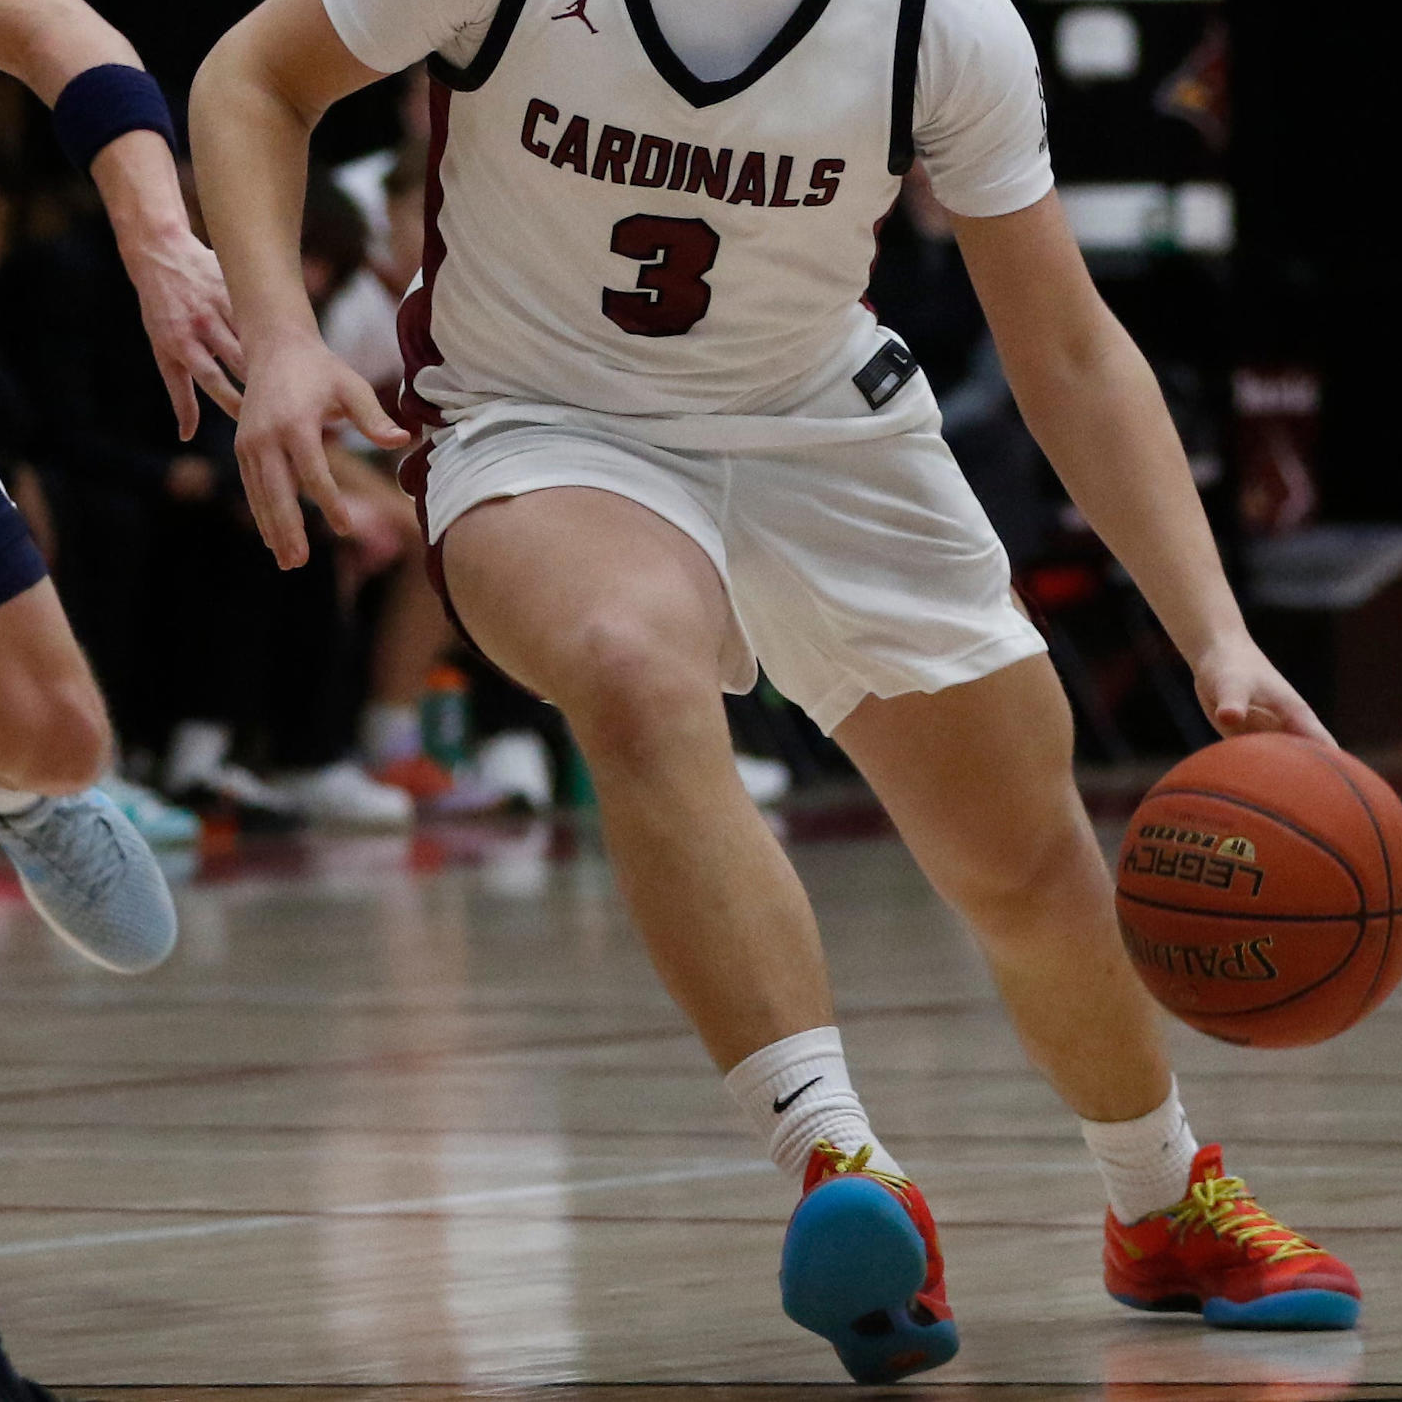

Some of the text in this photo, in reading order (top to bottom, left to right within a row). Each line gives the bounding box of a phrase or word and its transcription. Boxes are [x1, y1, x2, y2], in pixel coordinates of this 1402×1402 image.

[520, 97, 847, 209] CARDINALS
[601, 212, 721, 338] 3
[1124, 846, 1265, 897] LEGACY
[1125, 928, 1278, 982] SPAL
